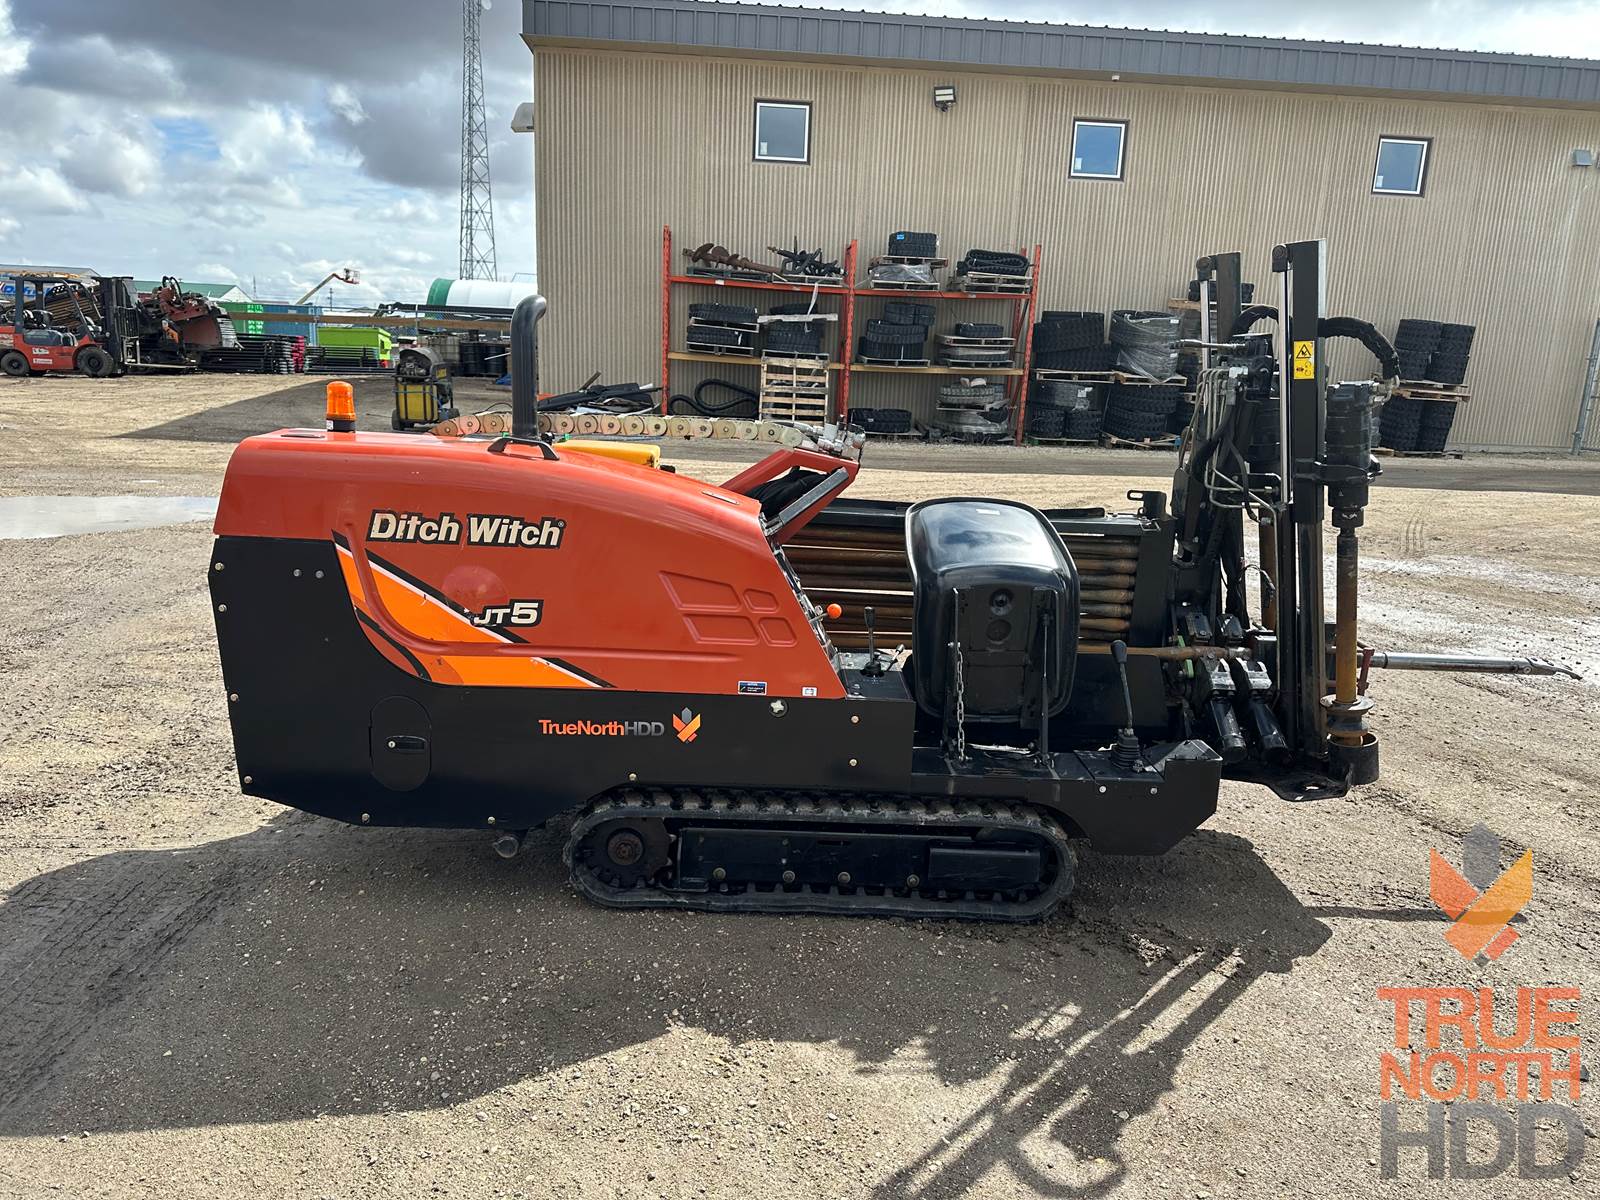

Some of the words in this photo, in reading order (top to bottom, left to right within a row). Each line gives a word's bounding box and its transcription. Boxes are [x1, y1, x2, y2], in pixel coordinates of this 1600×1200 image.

[369, 512, 459, 542] Ditch
[473, 601, 539, 625] JT5
[538, 719, 665, 737] TrueNorthHDD
